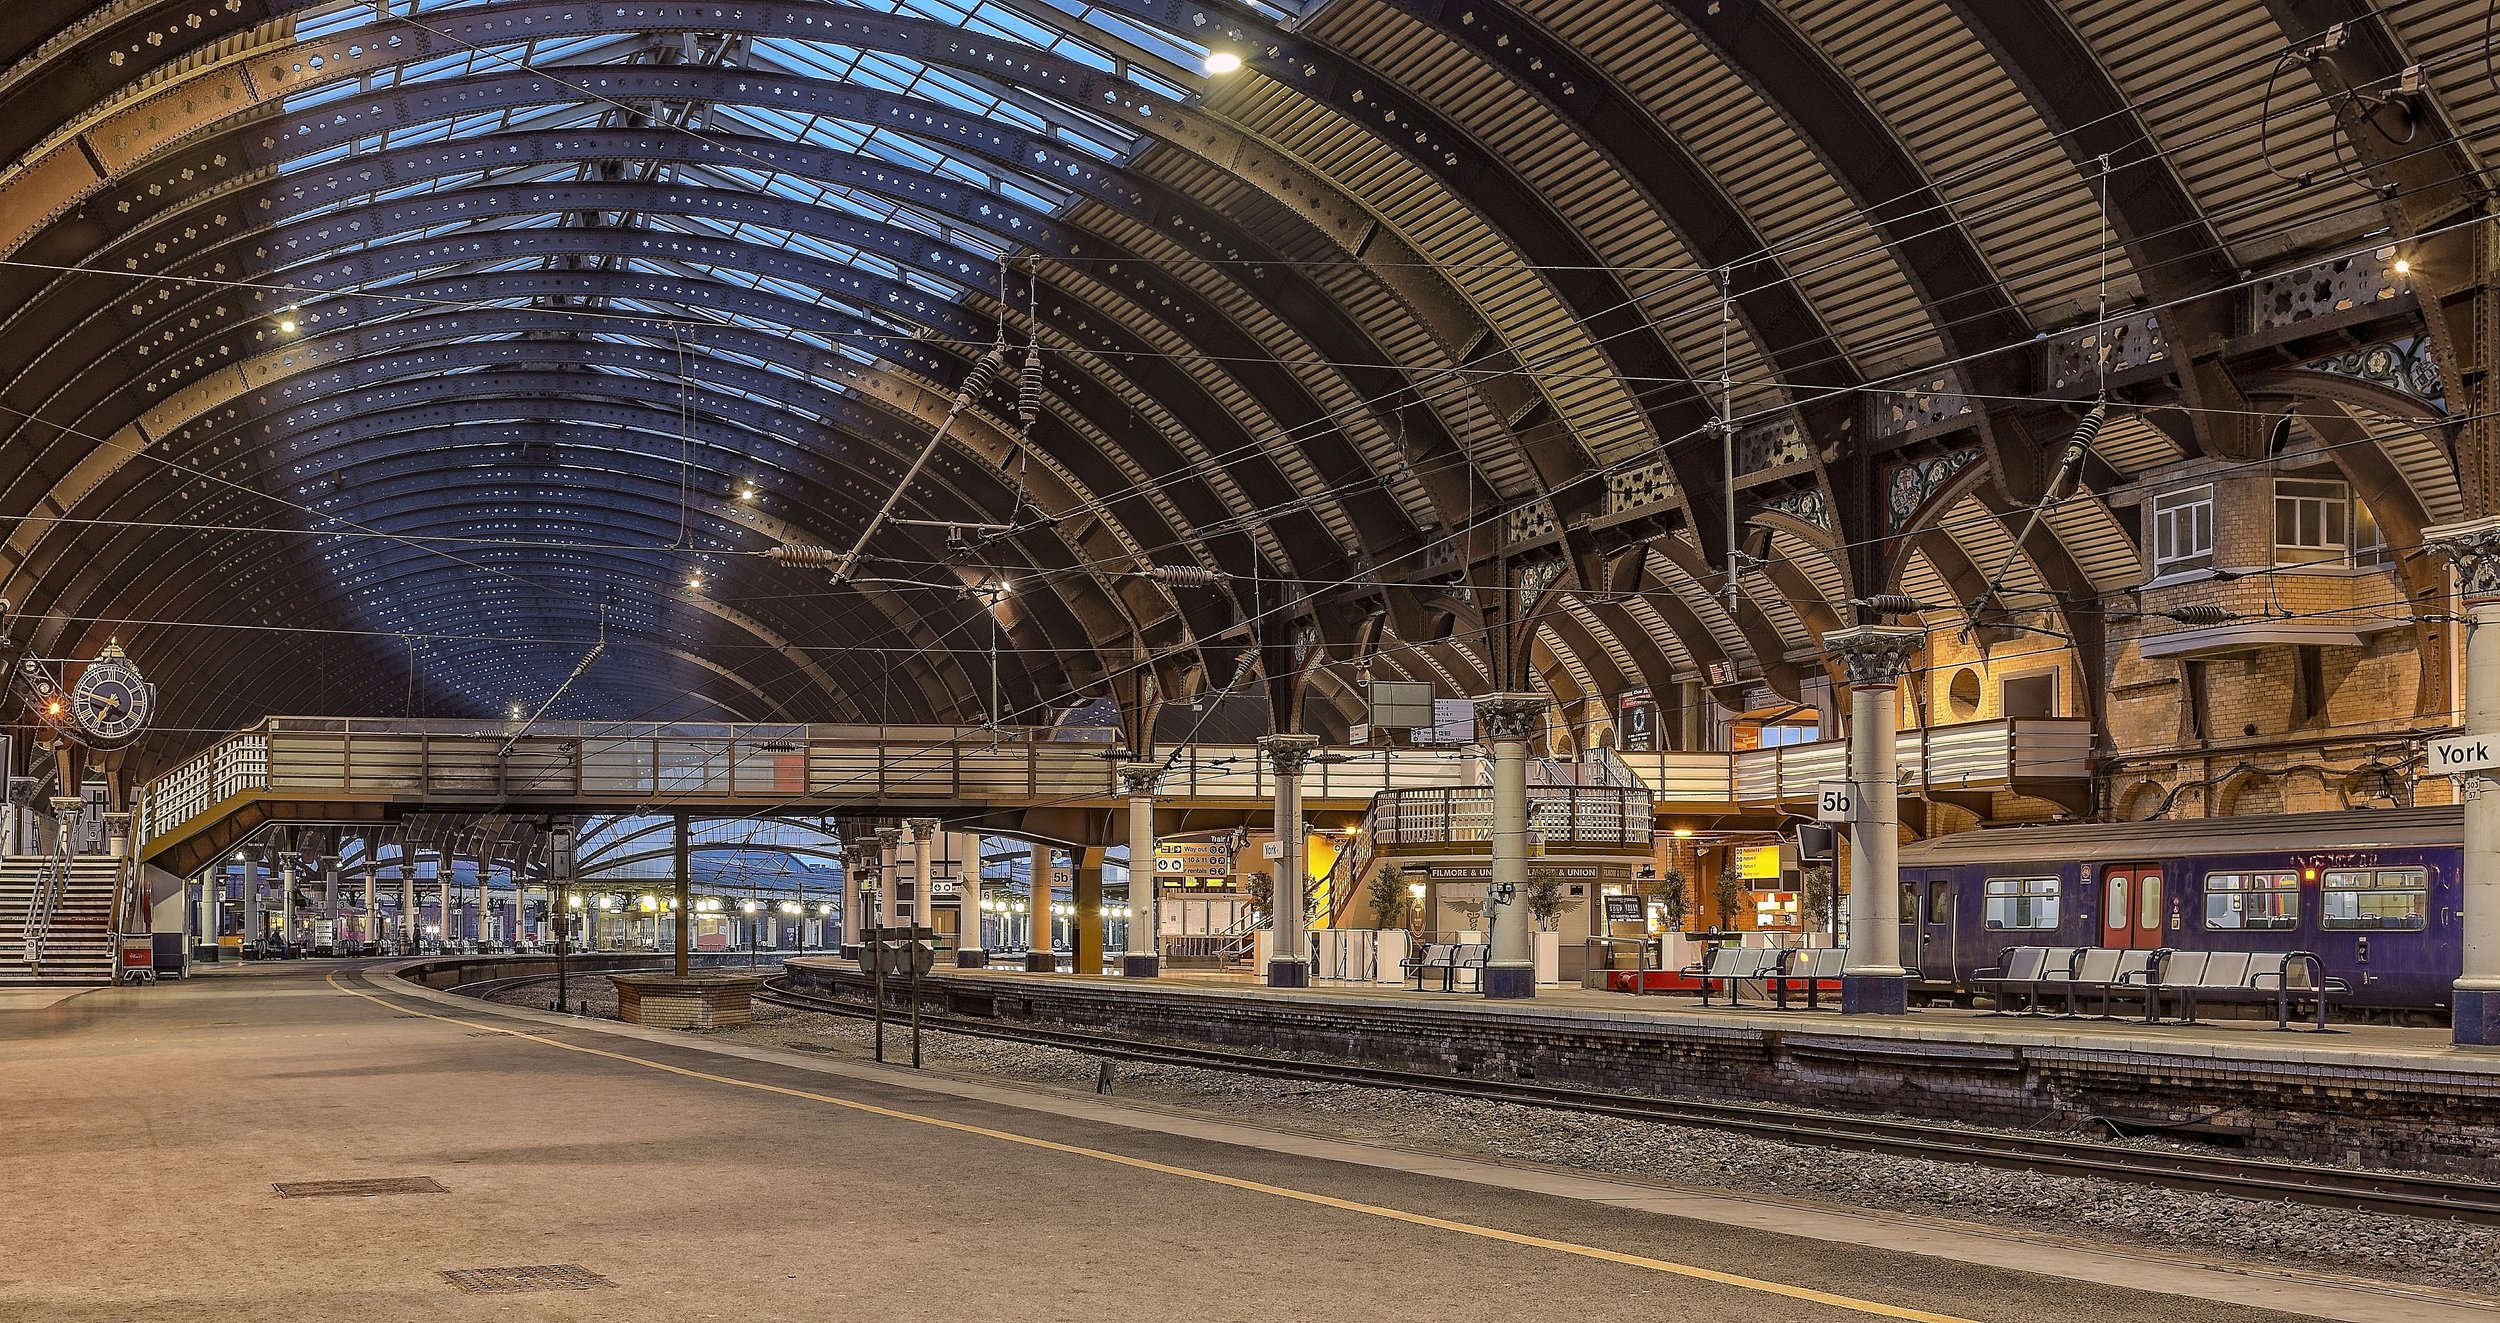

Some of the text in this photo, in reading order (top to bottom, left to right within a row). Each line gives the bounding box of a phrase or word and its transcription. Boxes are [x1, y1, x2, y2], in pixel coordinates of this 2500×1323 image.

[2437, 742, 2489, 764] York
[2466, 781, 2479, 789] 303
[1822, 791, 1850, 812] 5b
[1264, 844, 1277, 856] York
[1053, 872, 1069, 883] 5b
[1432, 869, 1467, 877] FILMORE
[984, 891, 990, 900] 6
